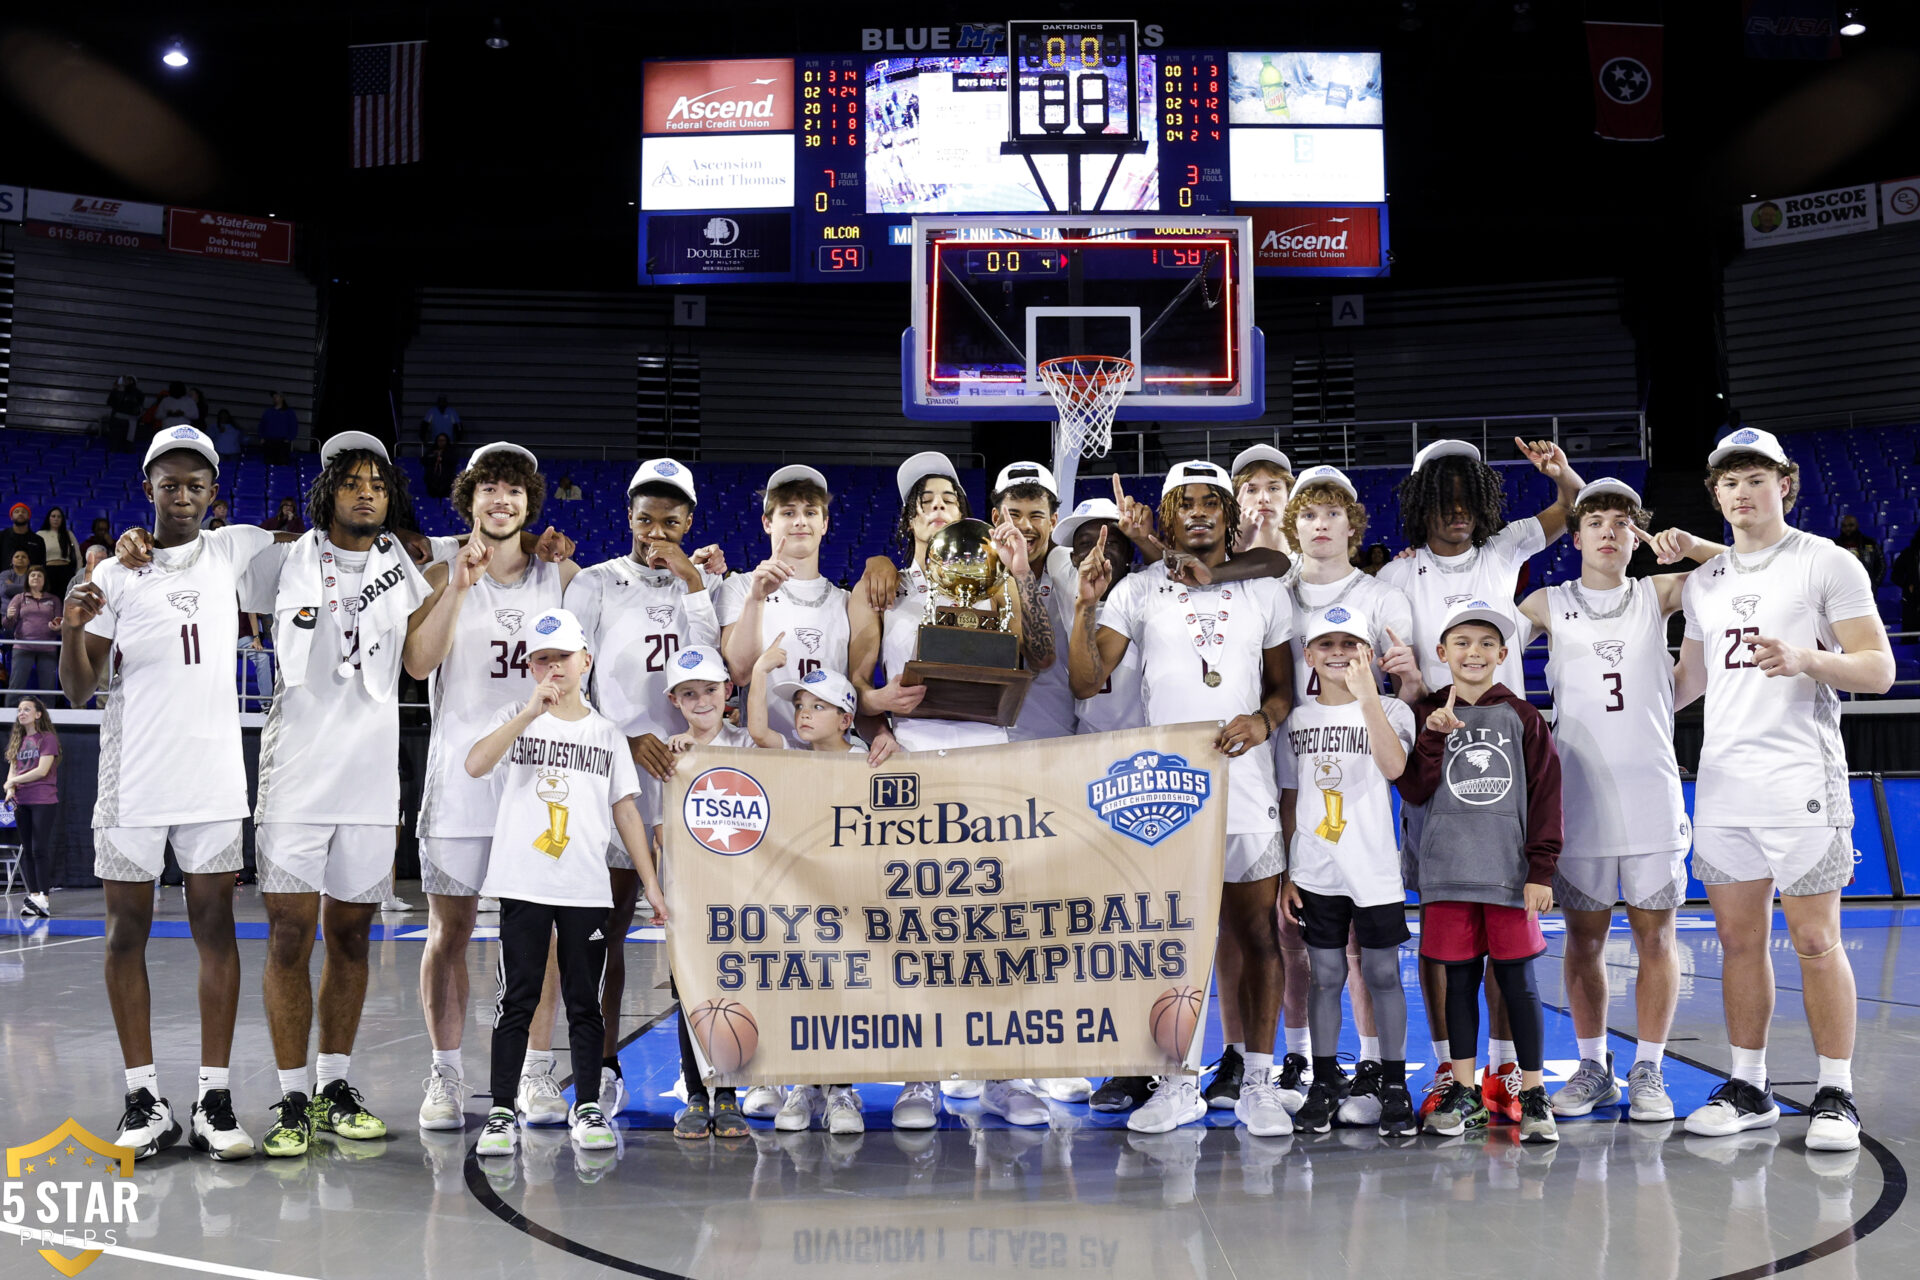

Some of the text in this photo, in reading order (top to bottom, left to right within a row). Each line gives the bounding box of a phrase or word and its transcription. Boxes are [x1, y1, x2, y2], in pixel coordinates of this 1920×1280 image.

[861, 28, 950, 50] BLUE
[804, 70, 857, 82] 01 3 14
[1165, 65, 1218, 77] 00 1 3
[804, 86, 857, 98] 02 4 24
[1165, 81, 1218, 93] 01 1 8
[667, 94, 774, 120] Ascend
[804, 102, 857, 114] 20 1 0
[1165, 97, 1219, 109] 02 4 12
[666, 119, 770, 129] Federal Credit Union
[804, 118, 857, 130] 21 1 8
[1165, 113, 1219, 125] 03 1 9
[805, 134, 857, 147] 30 1 6
[1166, 130, 1219, 141] 04 2 4
[688, 156, 762, 170] Ascension
[688, 173, 786, 186] Saint Thomas
[824, 169, 836, 188] 7
[1187, 165, 1199, 185] 3
[91, 200, 122, 214] LEE
[815, 192, 828, 212] 0
[1179, 187, 1192, 207] 0
[1785, 189, 1867, 213] ROSCOE
[1787, 204, 1867, 229] BROWN
[48, 226, 140, 248] 615.867.1000
[208, 236, 228, 246] Deb
[823, 226, 860, 239] ALCOA
[1260, 230, 1348, 250] Ascend
[831, 248, 859, 270] 59
[1259, 250, 1345, 259] Federal Credit Union
[681, 302, 698, 320] T
[1339, 302, 1357, 320] A
[926, 397, 959, 405] SPALDING
[181, 623, 201, 665] 11
[1725, 627, 1760, 670] 23
[490, 640, 530, 678] 34
[1602, 672, 1625, 713] 3
[1321, 725, 1372, 755] DESTINAT
[1448, 728, 1511, 752] CITY
[548, 740, 613, 778] DESTINATION
[537, 769, 569, 780] CITY
[875, 777, 916, 807] FB
[1092, 770, 1206, 806] BLUECROSS
[691, 798, 762, 819] TSSAA
[1104, 794, 1196, 812] STATE CHAMPIONSHIPS
[695, 819, 757, 828] CHAMPIONSHIPS
[830, 797, 1057, 848] FirstBank
[884, 857, 1004, 899] 2023
[706, 891, 1195, 944] BOYS' BASKETBALL
[716, 939, 1187, 992] STATE CHAMPIONS
[790, 1006, 1119, 1051] DIVISION I CLASS 2A
